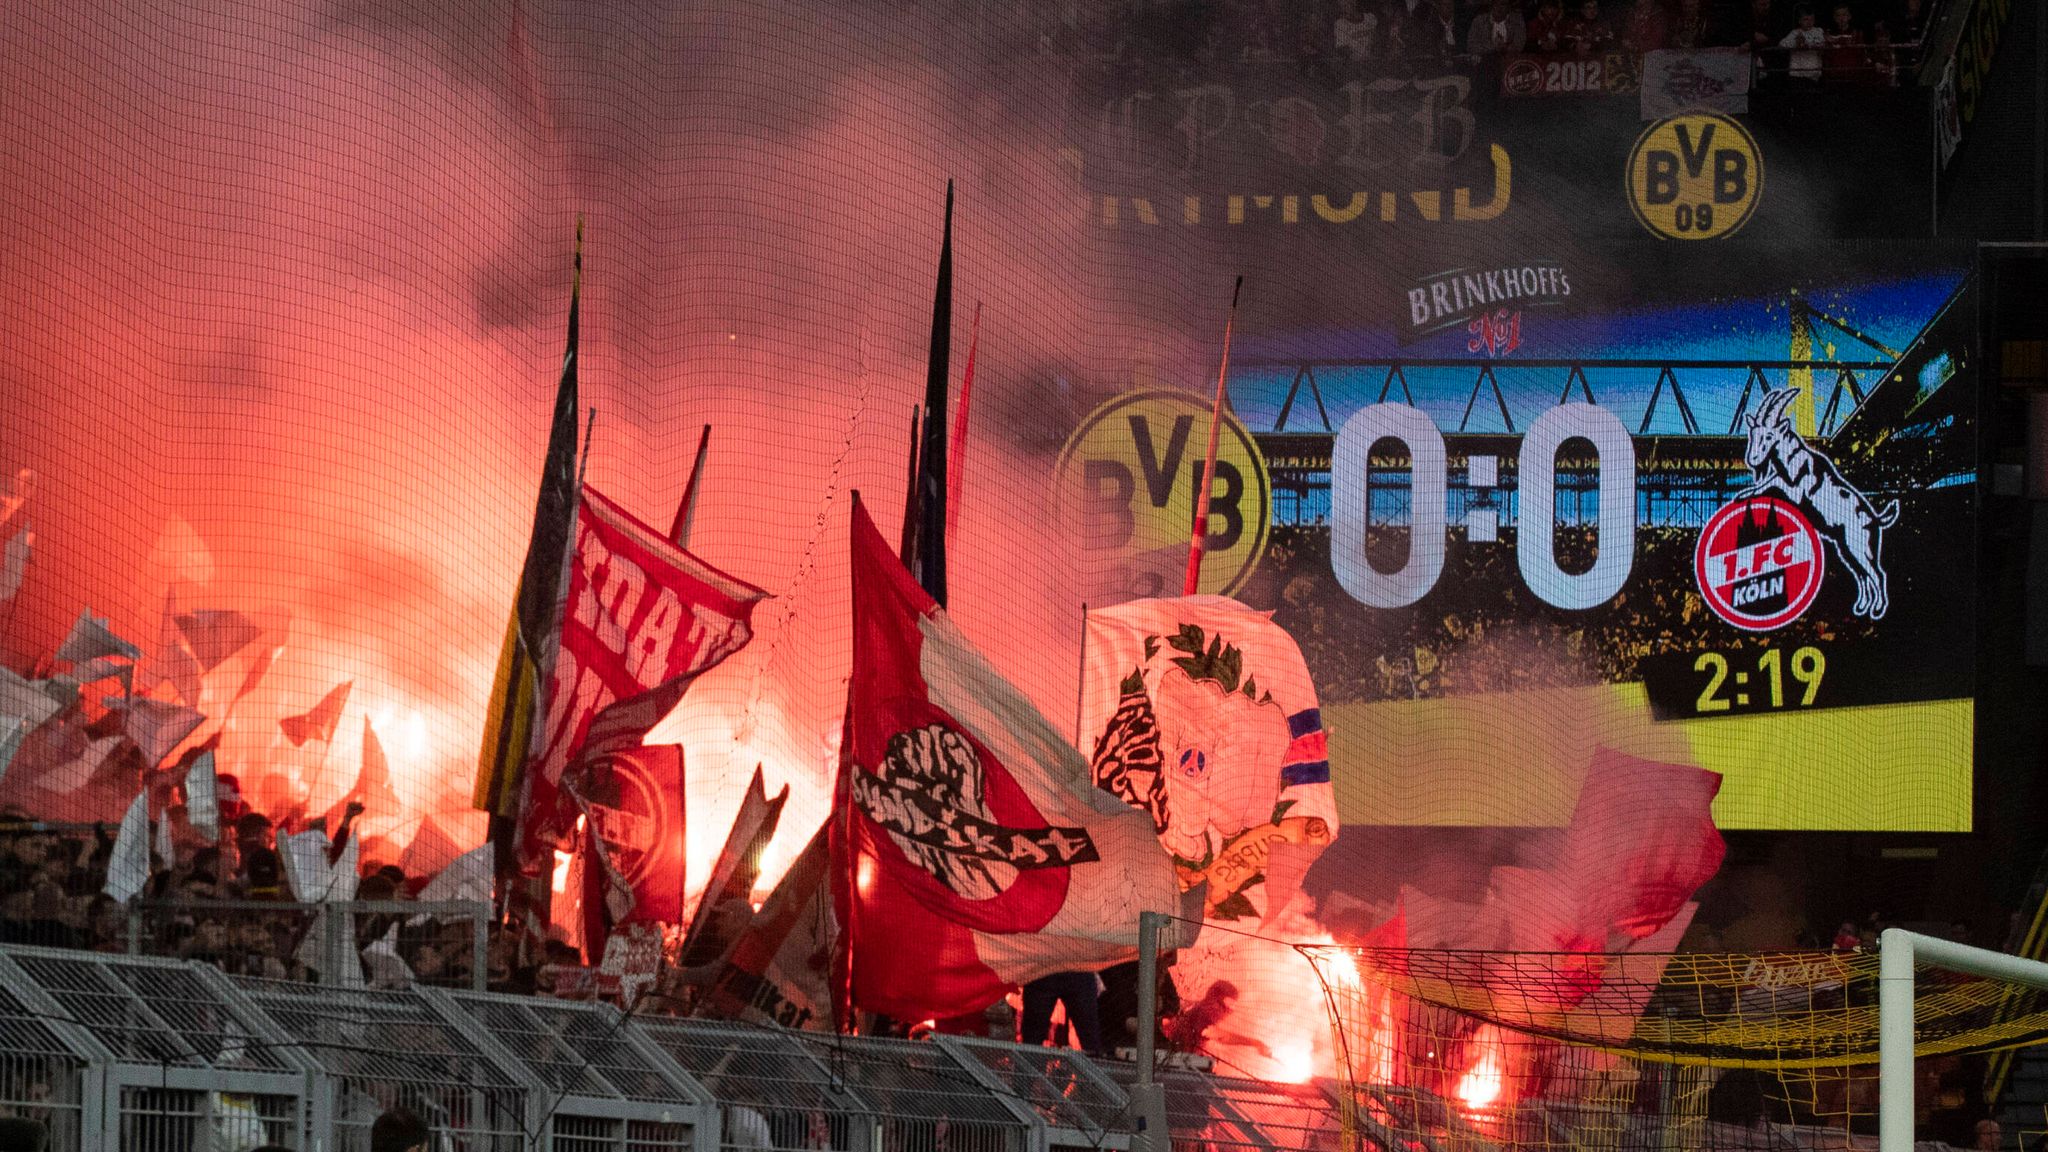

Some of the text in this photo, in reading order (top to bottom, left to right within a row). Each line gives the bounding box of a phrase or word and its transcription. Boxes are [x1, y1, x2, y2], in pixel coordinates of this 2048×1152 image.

[1546, 60, 1601, 91] 2012
[1645, 123, 1748, 206] BVB
[1674, 203, 1714, 233] 09
[1083, 415, 1245, 552] BVB
[1732, 575, 1785, 608] KÖLN
[1693, 646, 1827, 712] 2:19
